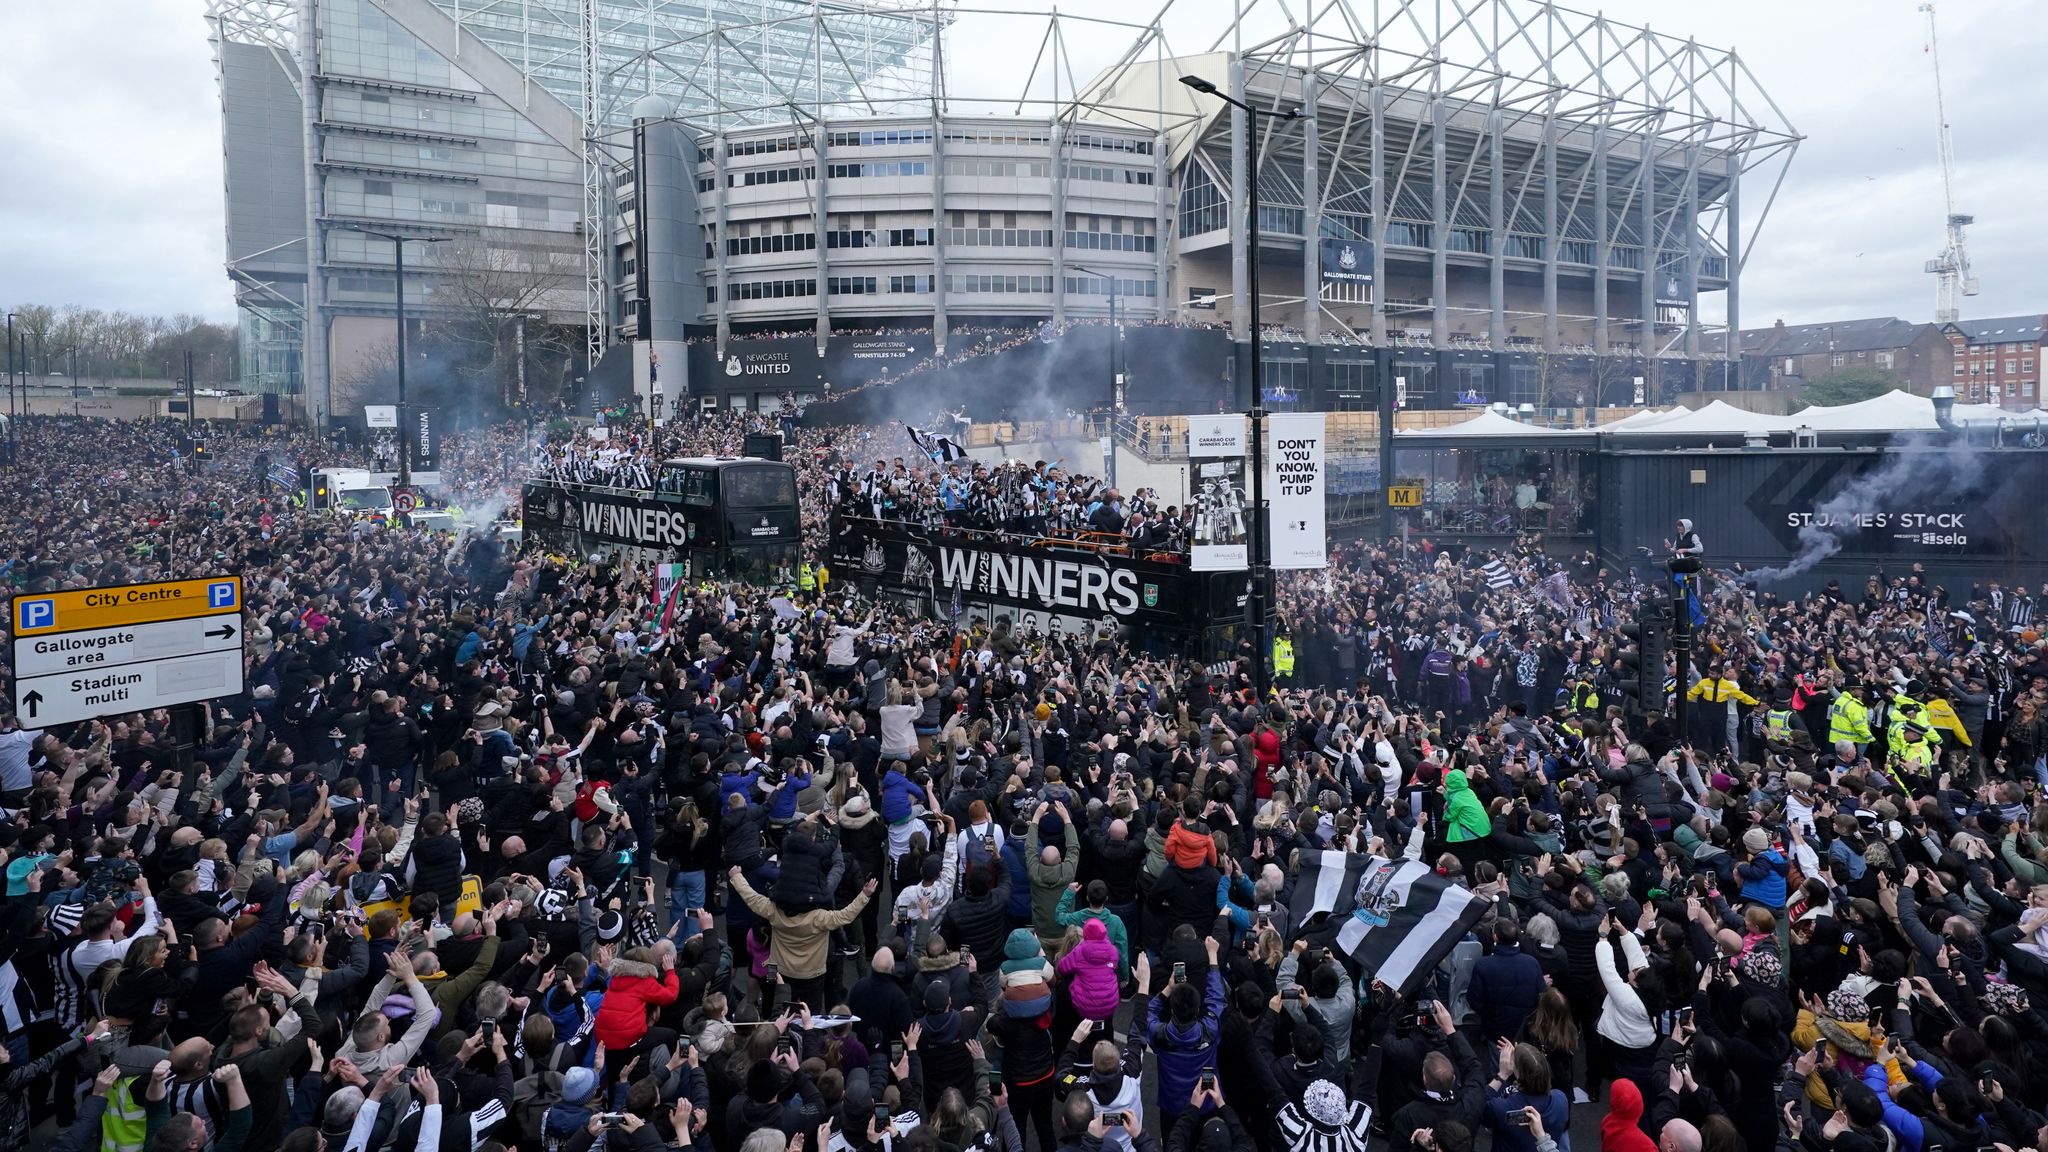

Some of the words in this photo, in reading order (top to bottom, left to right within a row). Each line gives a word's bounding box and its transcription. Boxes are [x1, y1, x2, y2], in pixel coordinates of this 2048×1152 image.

[1323, 271, 1356, 279] GALLOWGATE
[746, 353, 789, 361] NEWCASTLE
[746, 363, 791, 375] UNITED
[420, 412, 430, 457] WINNERS
[1277, 439, 1317, 449] DON'T
[1284, 451, 1310, 461] YOU
[1276, 463, 1318, 473] KNOW,
[1279, 474, 1315, 484] PUMP
[1282, 486, 1294, 495] IT
[1295, 486, 1312, 495] UP
[1394, 490, 1410, 503] M
[1935, 532, 1967, 545] sela
[978, 551, 990, 593] 24/25
[85, 592, 120, 607] City
[127, 587, 182, 602] Centre
[215, 584, 232, 606] P
[29, 602, 50, 627] P
[34, 632, 135, 654] Gallowgate
[66, 652, 105, 666] area
[70, 672, 142, 692] Stadium
[85, 688, 129, 706] multi
